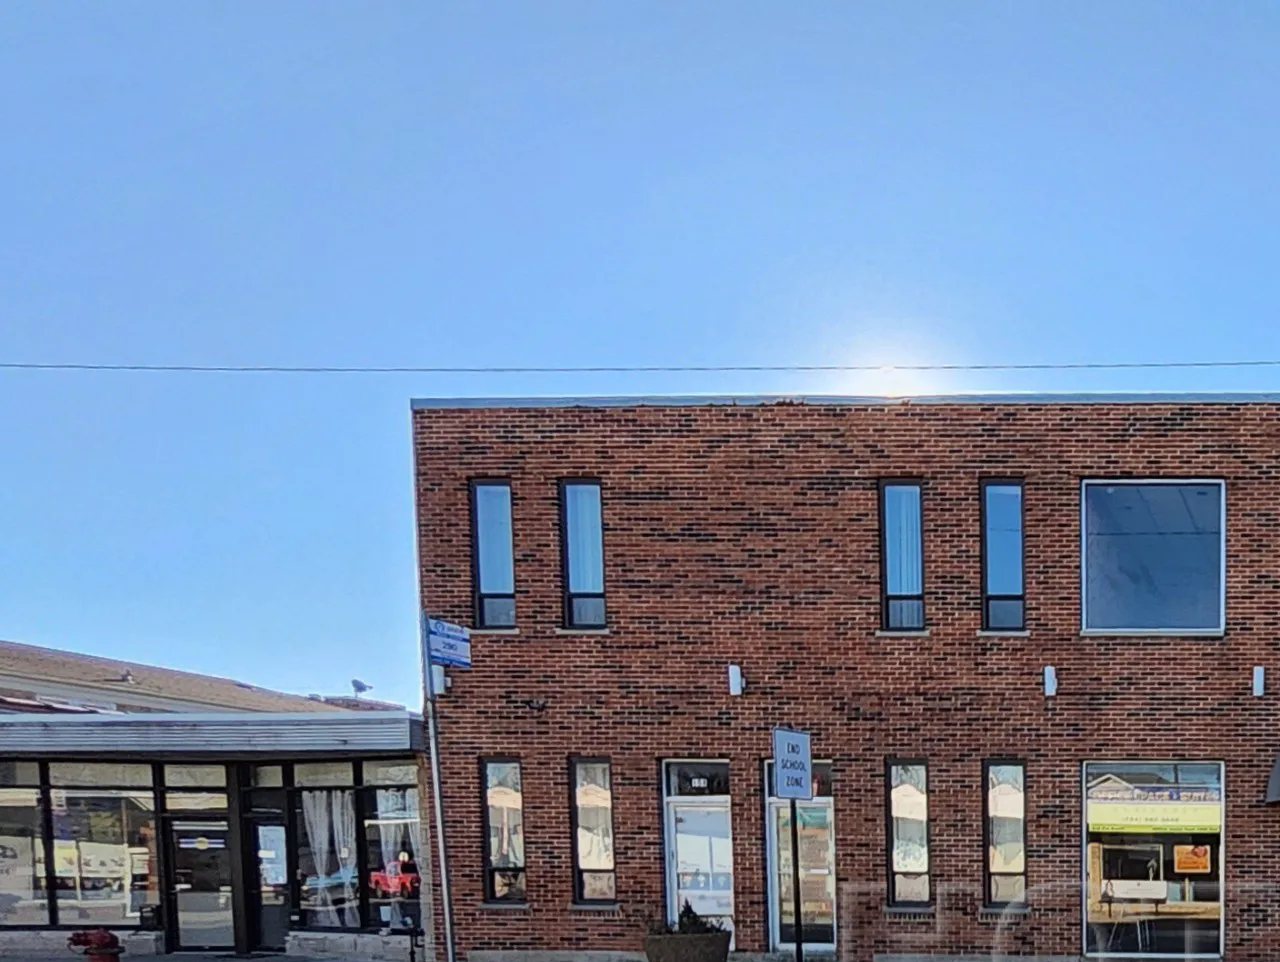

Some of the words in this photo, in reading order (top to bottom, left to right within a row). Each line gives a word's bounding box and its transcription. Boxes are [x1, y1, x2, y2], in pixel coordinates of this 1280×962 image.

[787, 742, 801, 755] END
[781, 758, 808, 773] SCHOOL
[786, 775, 804, 789] ZONE
